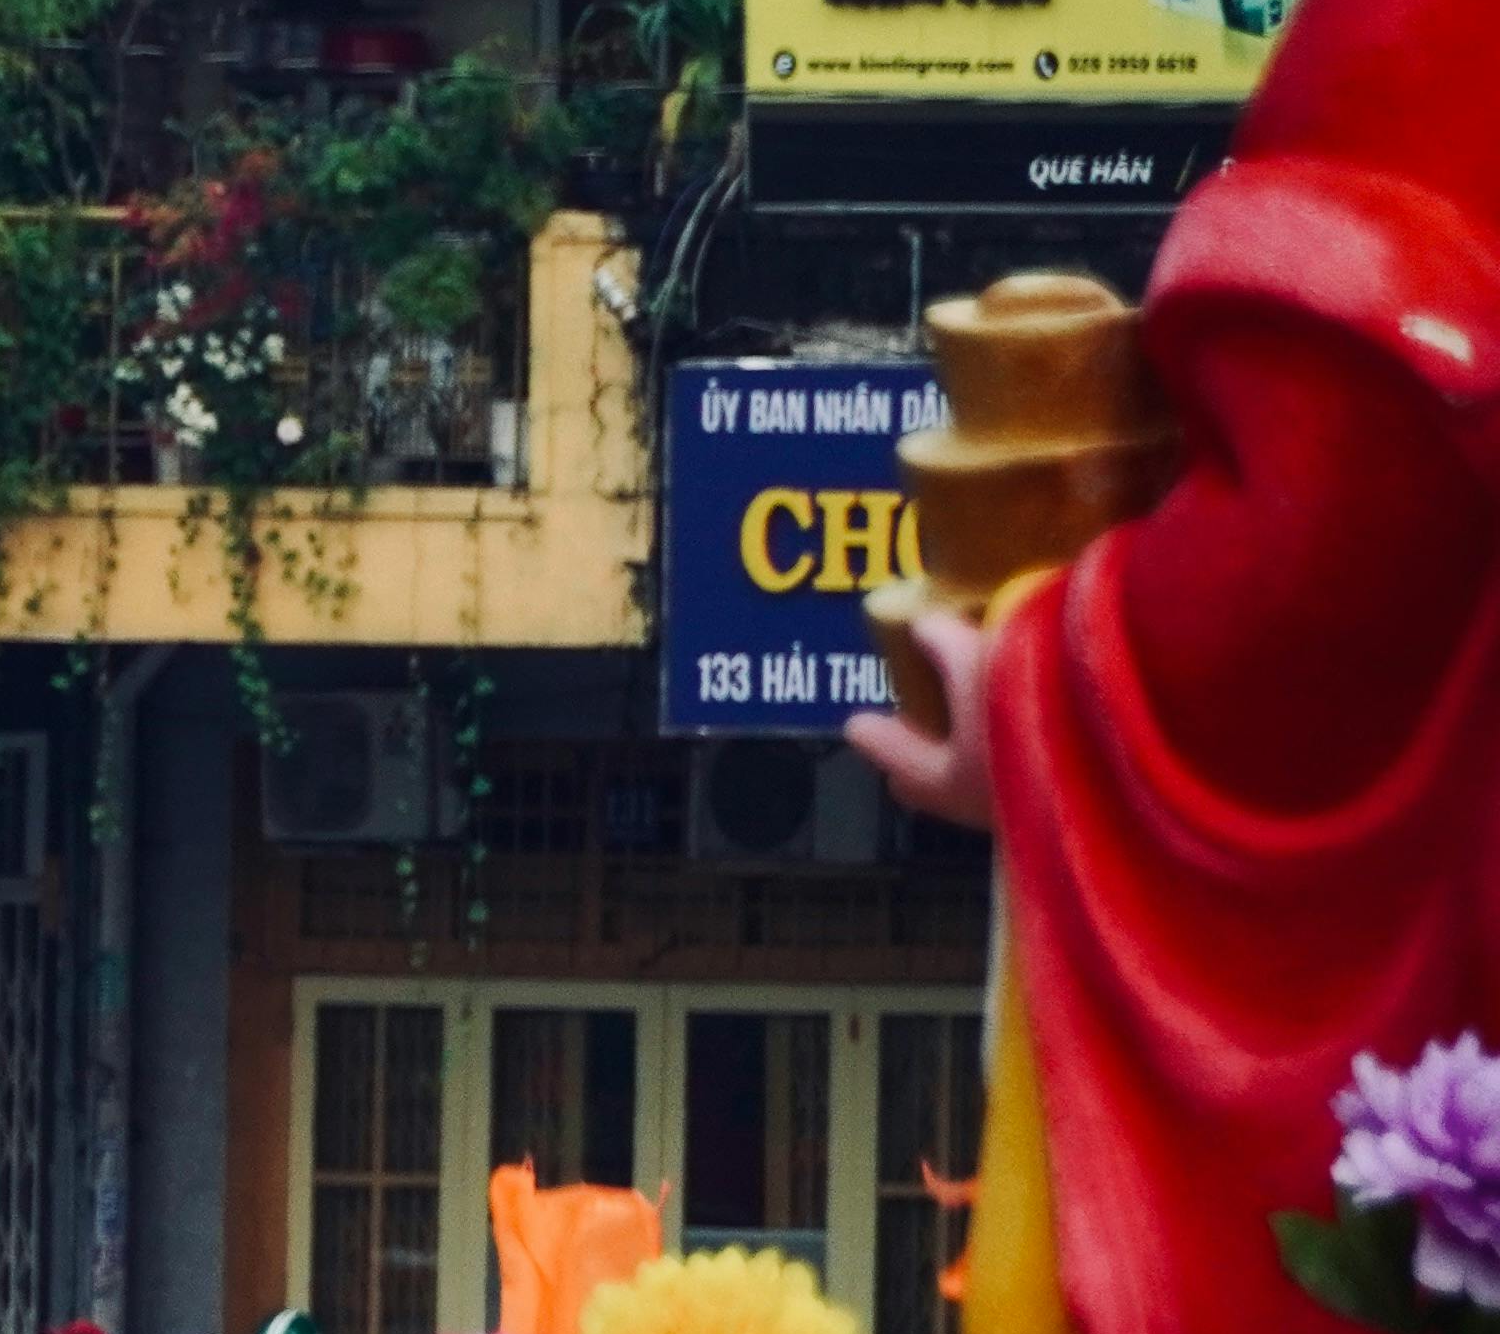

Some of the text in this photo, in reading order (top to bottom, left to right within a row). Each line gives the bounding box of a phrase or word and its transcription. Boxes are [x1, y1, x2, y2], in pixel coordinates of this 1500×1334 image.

[1029, 154, 1085, 190] QUE
[749, 388, 807, 434] BAN
[813, 381, 891, 434] NHÂN
[699, 652, 751, 703] 133
[762, 640, 818, 703] HẢI
